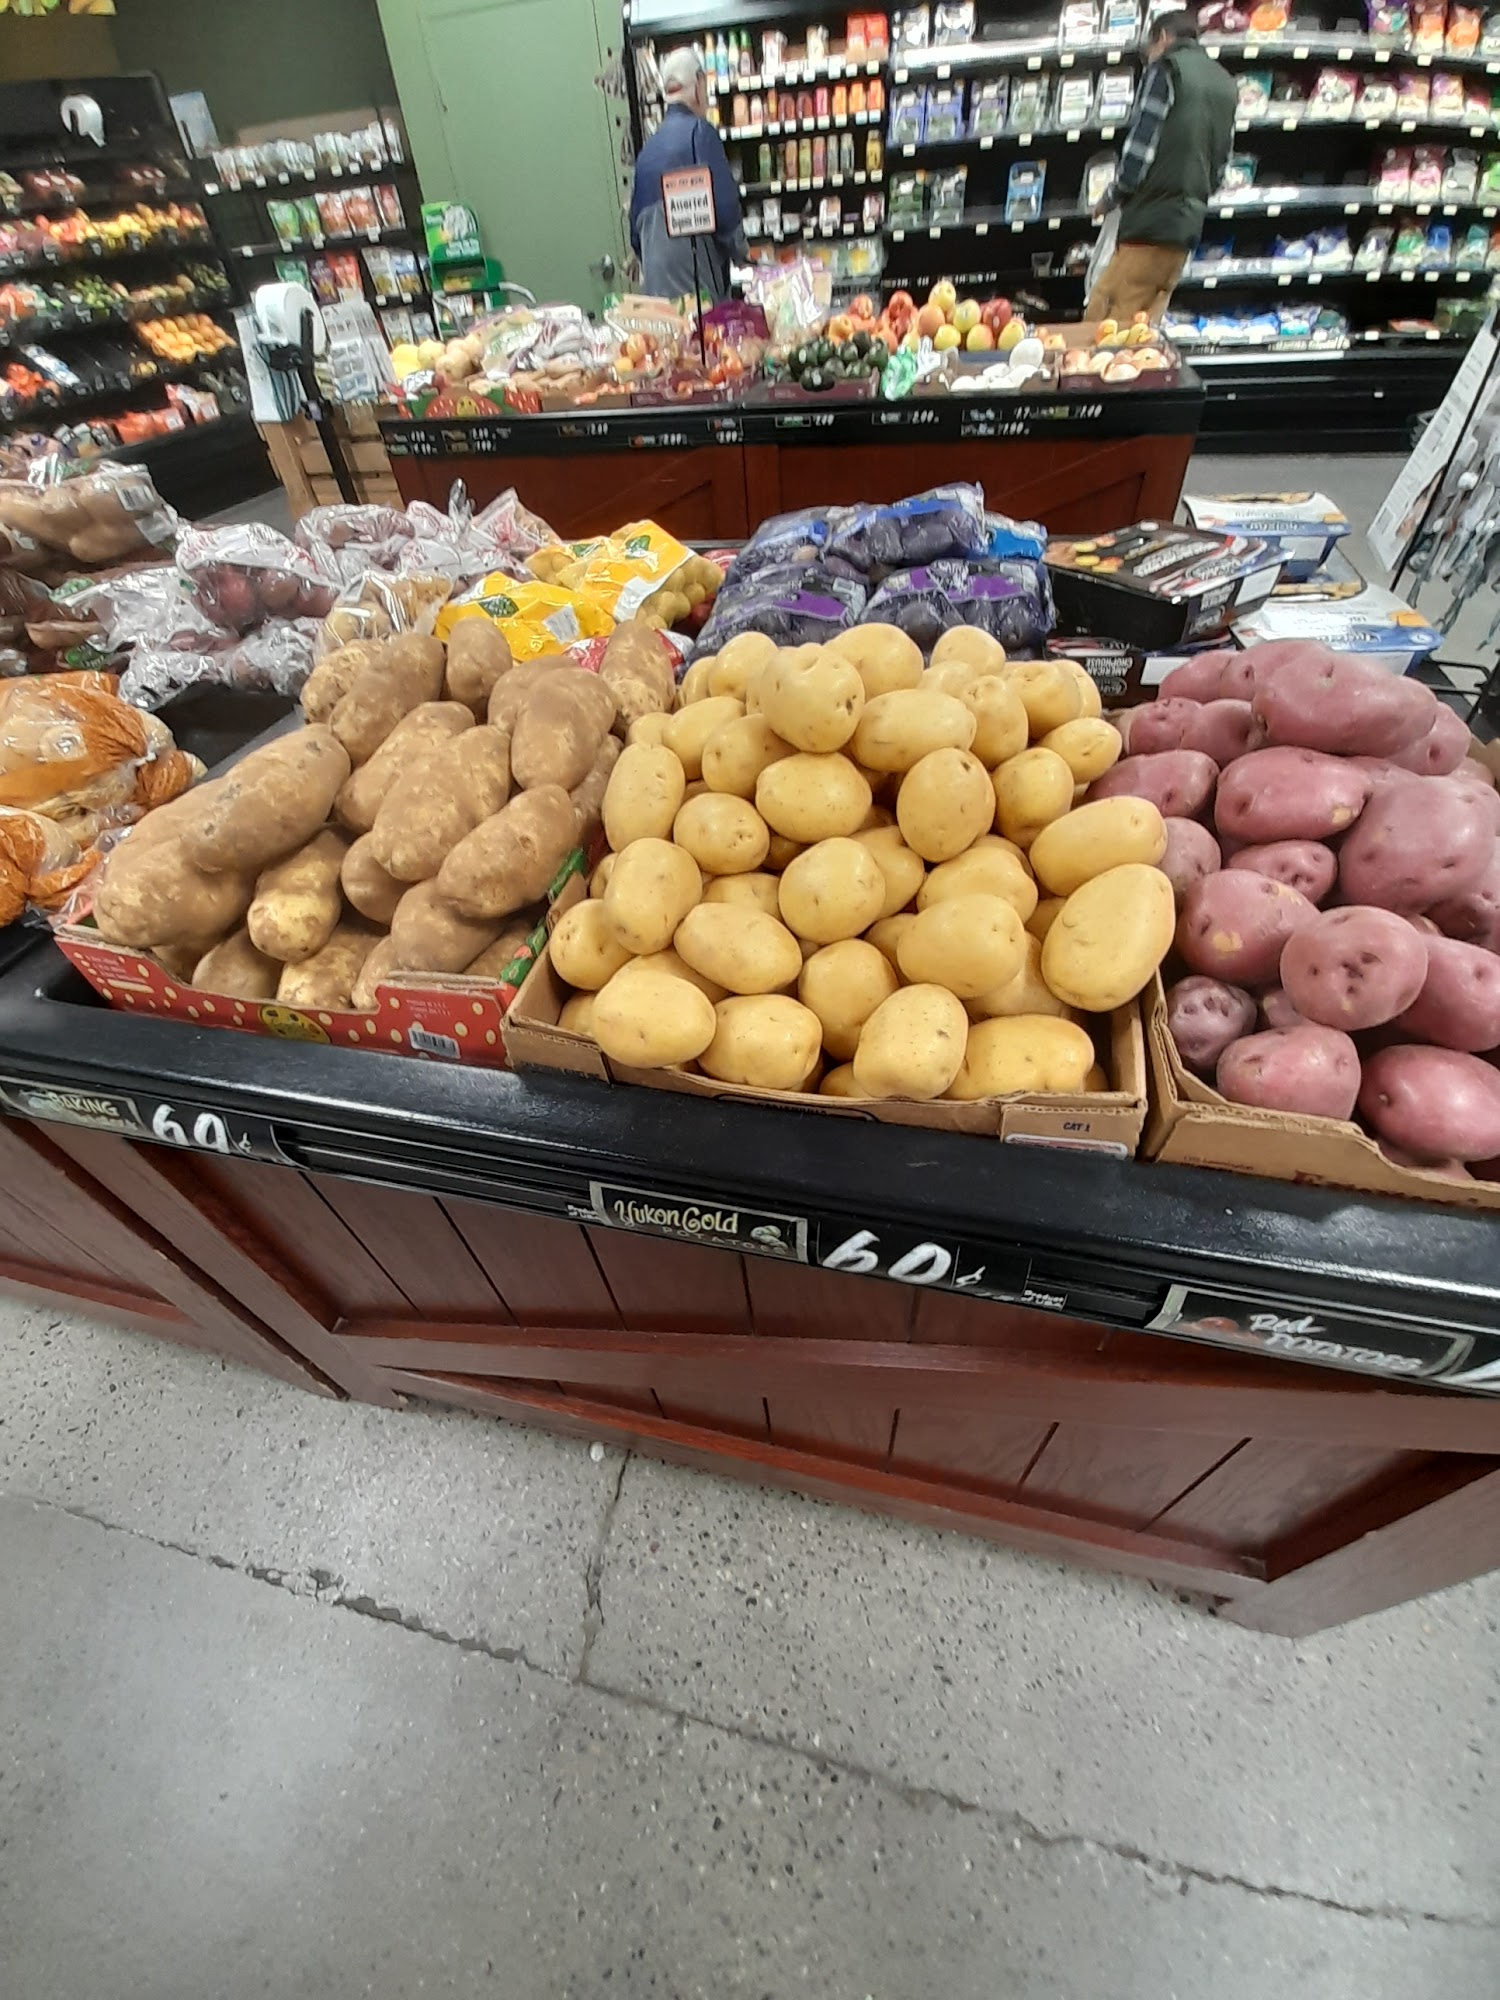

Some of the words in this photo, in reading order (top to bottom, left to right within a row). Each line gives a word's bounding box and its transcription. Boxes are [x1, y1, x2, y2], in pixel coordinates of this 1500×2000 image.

[48, 1091, 120, 1117] BAKING
[1063, 1121, 1083, 1132] CAT
[614, 1200, 680, 1228] Yukon
[682, 1206, 739, 1233] Gold
